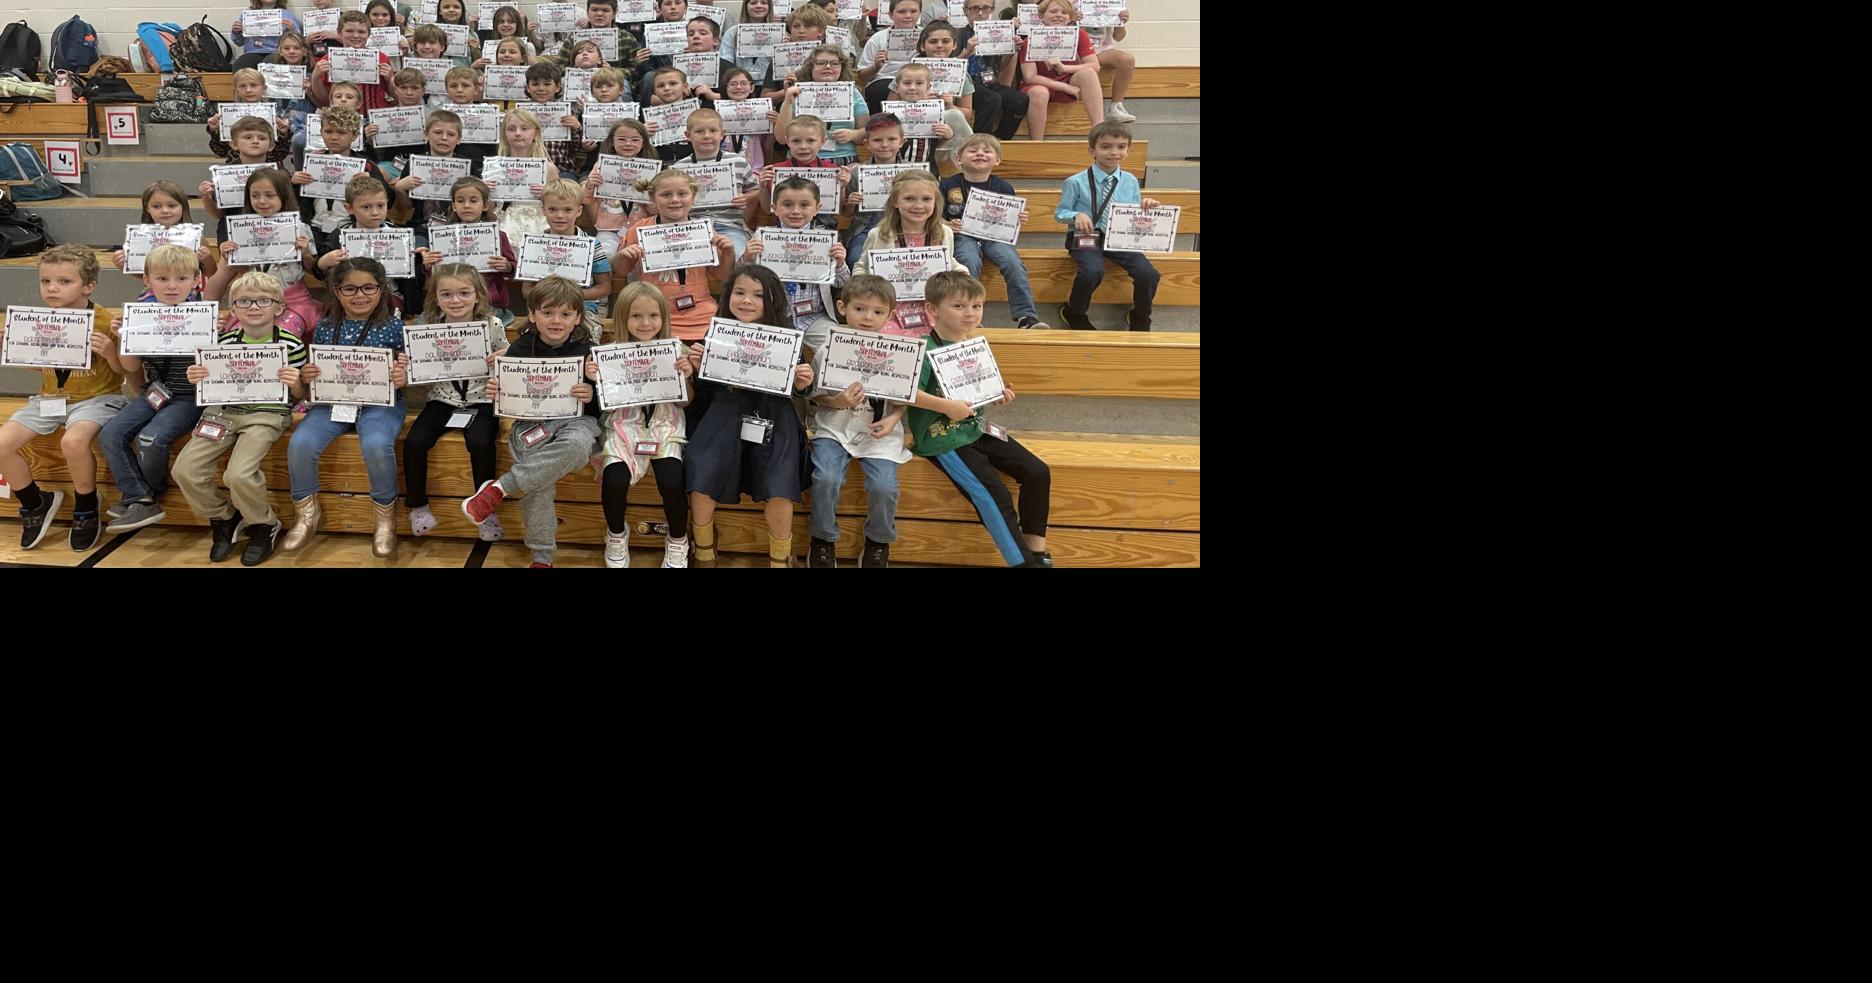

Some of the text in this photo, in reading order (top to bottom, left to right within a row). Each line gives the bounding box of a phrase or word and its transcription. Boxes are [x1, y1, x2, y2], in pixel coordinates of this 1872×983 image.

[119, 118, 125, 127] 5
[58, 154, 66, 164] 4
[718, 327, 745, 338] Student
[758, 333, 767, 341] the
[769, 334, 792, 344] Month
[740, 339, 766, 348] SEPTEMBER
[835, 336, 864, 347] Student
[878, 342, 888, 350] the
[891, 343, 915, 353] Month
[601, 352, 627, 361] Student
[650, 348, 672, 357] Month
[860, 349, 887, 357] SEPTEMBER
[938, 353, 956, 364] Student
[972, 346, 984, 356] Month
